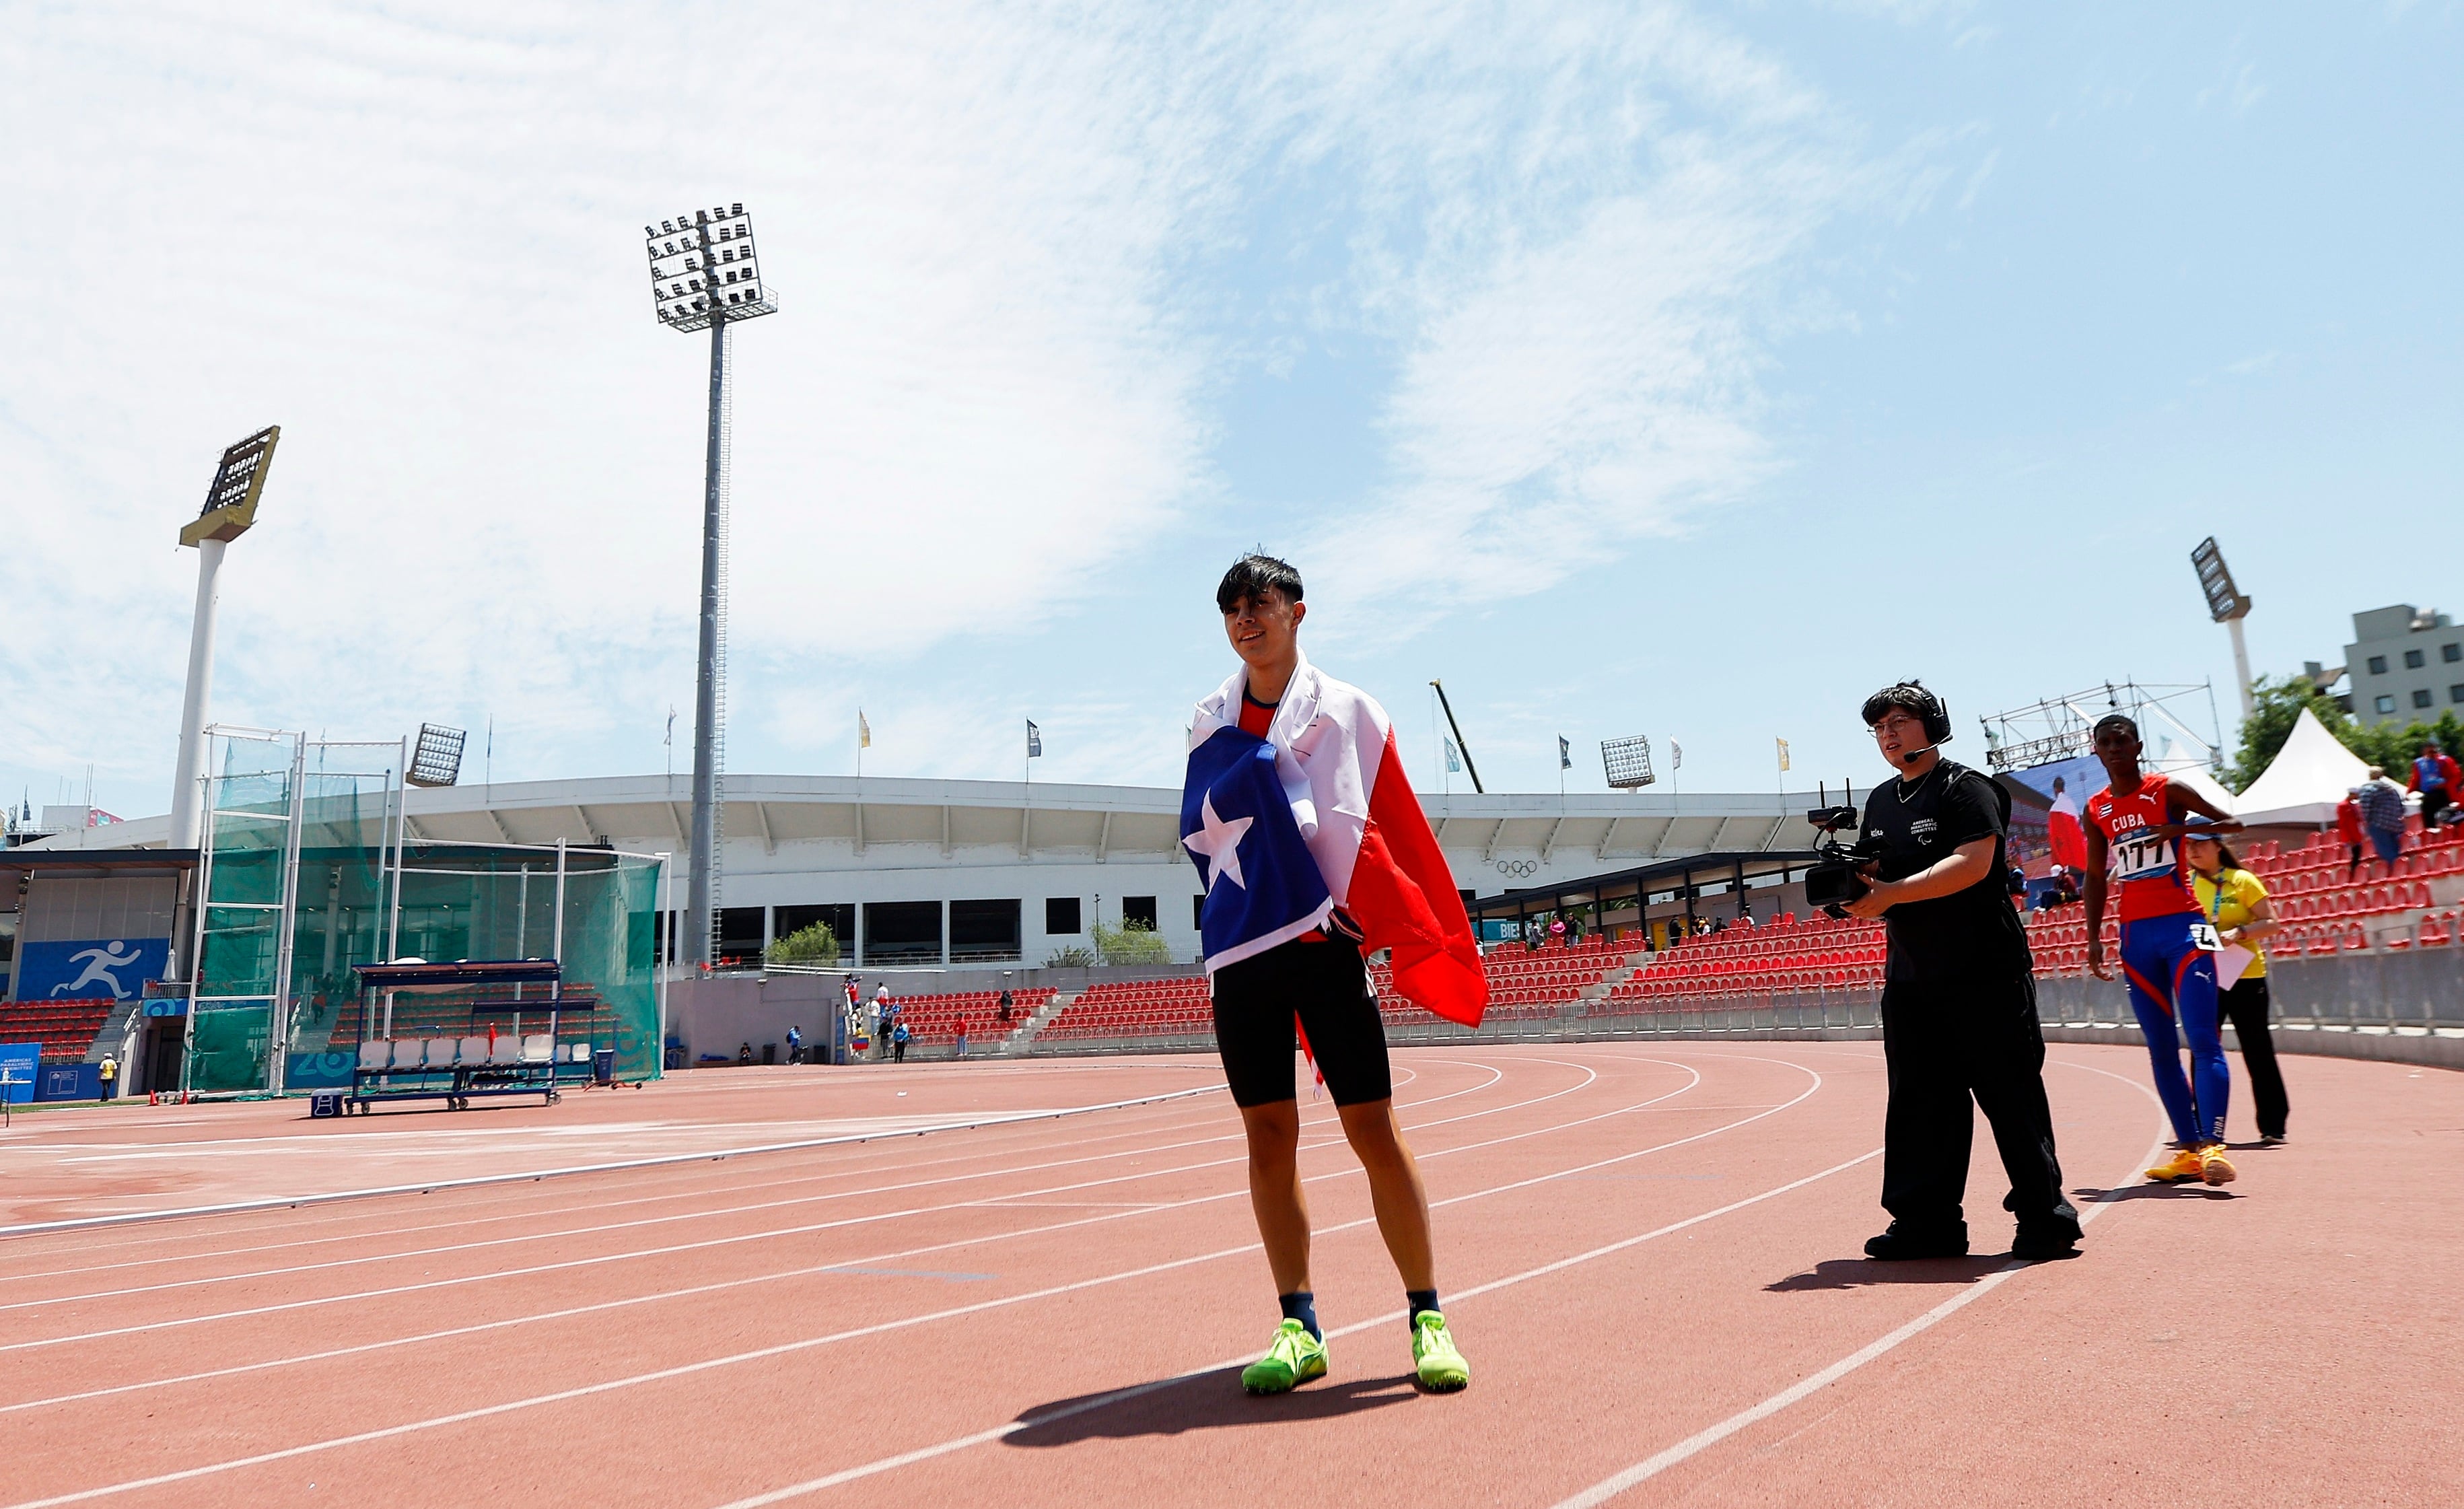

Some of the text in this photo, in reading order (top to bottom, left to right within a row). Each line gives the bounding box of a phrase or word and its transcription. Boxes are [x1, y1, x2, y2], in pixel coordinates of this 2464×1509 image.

[1911, 827, 1937, 835] COMMITTEE
[2112, 813, 2146, 832] CUBA
[2119, 837, 2164, 872] 177
